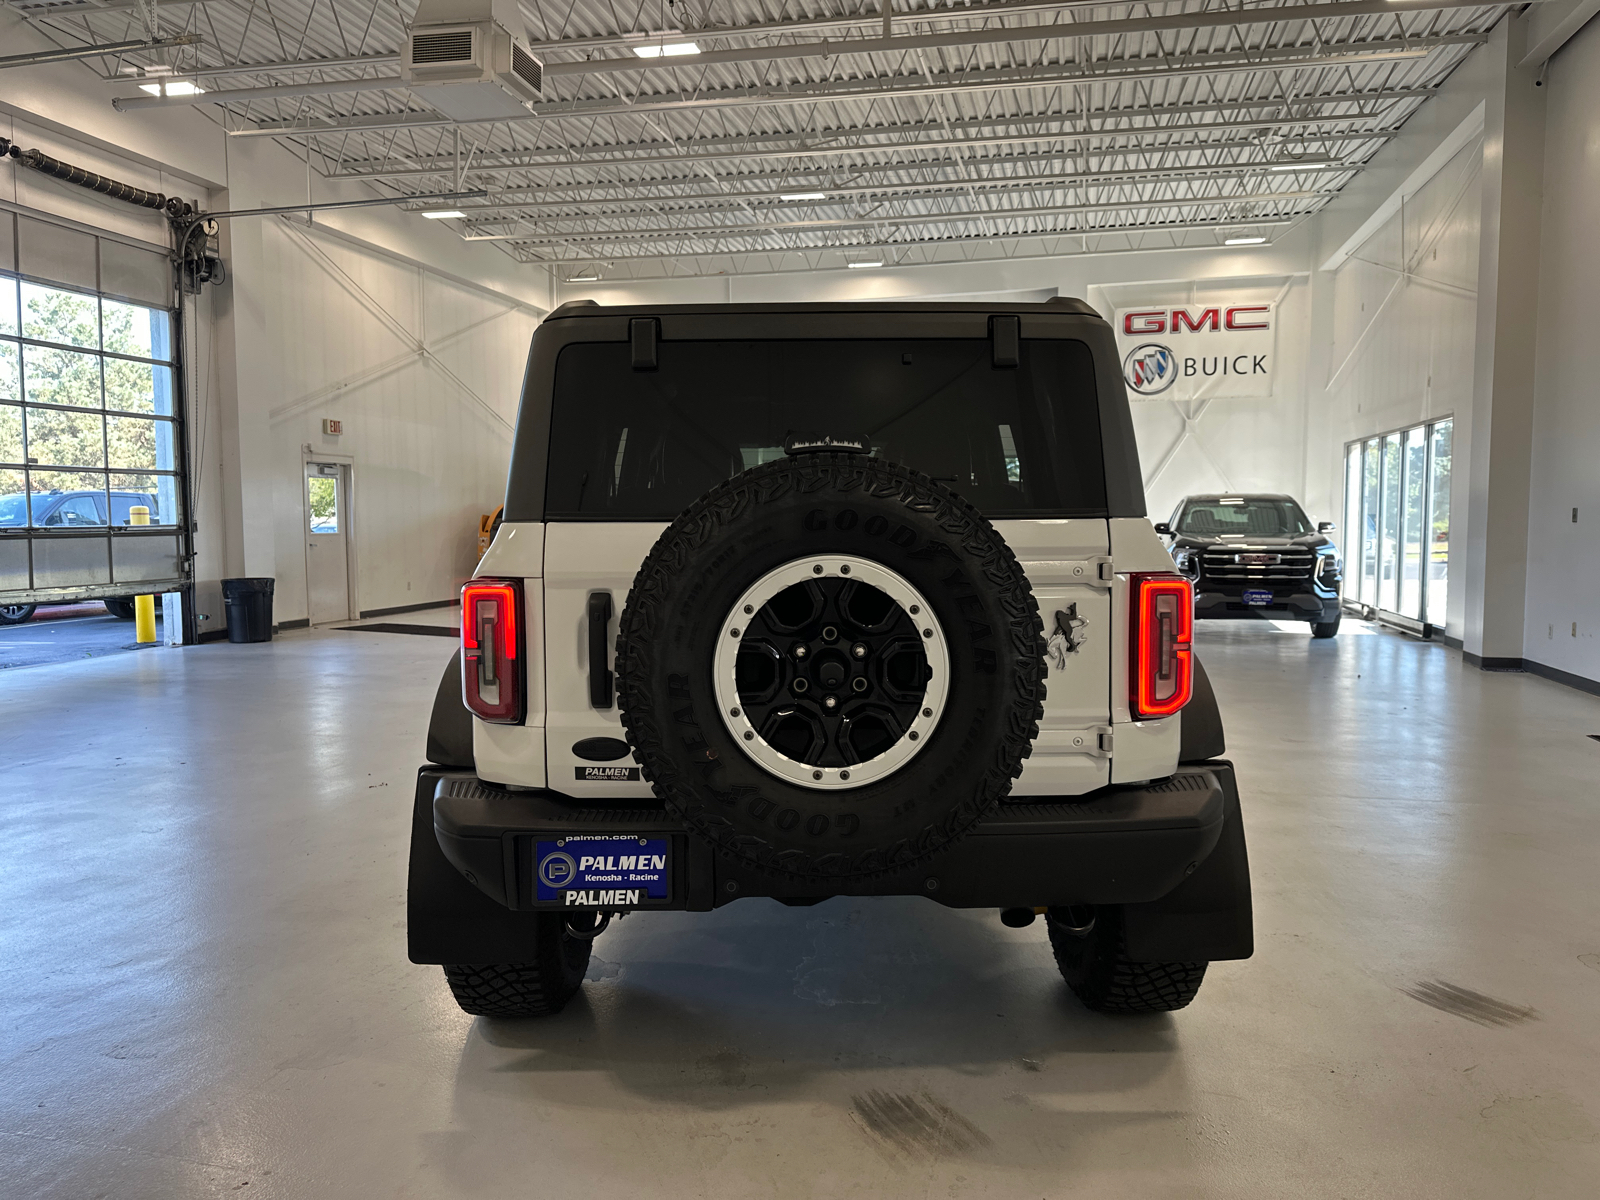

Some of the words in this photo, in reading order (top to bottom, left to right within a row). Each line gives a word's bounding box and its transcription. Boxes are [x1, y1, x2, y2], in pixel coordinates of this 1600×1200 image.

[1123, 304, 1271, 336] GMC
[1184, 355, 1267, 376] BUICK
[330, 420, 341, 433] EXIT
[585, 767, 630, 776] PALMEN
[579, 855, 666, 871] PALMEN
[585, 874, 622, 882] Kenosha
[565, 889, 640, 906] PALMEN
